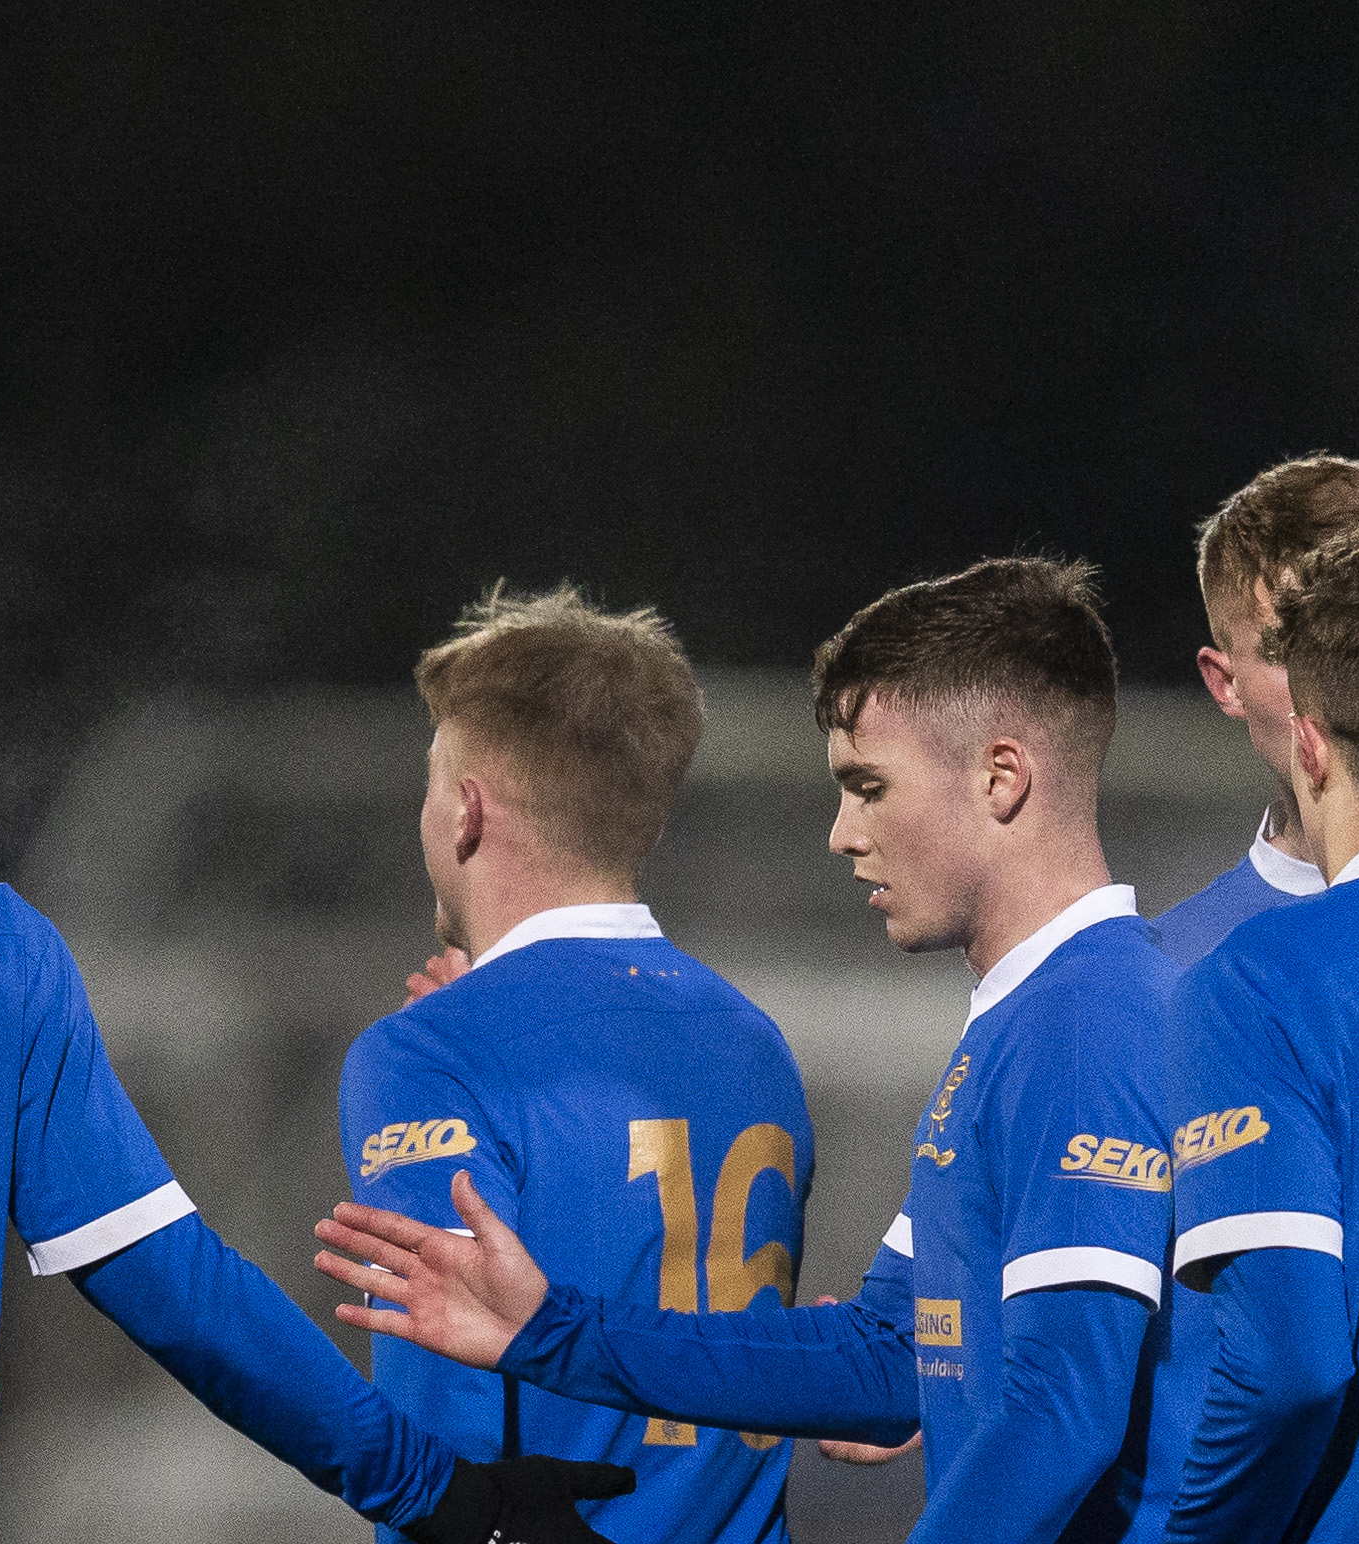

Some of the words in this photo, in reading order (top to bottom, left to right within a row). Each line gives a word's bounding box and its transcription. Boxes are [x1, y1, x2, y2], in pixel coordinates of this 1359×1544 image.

[361, 1118, 478, 1178] SEKO
[1060, 1133, 1173, 1192] SEKO
[1173, 1106, 1270, 1161] SEKO
[628, 1118, 796, 1450] 16
